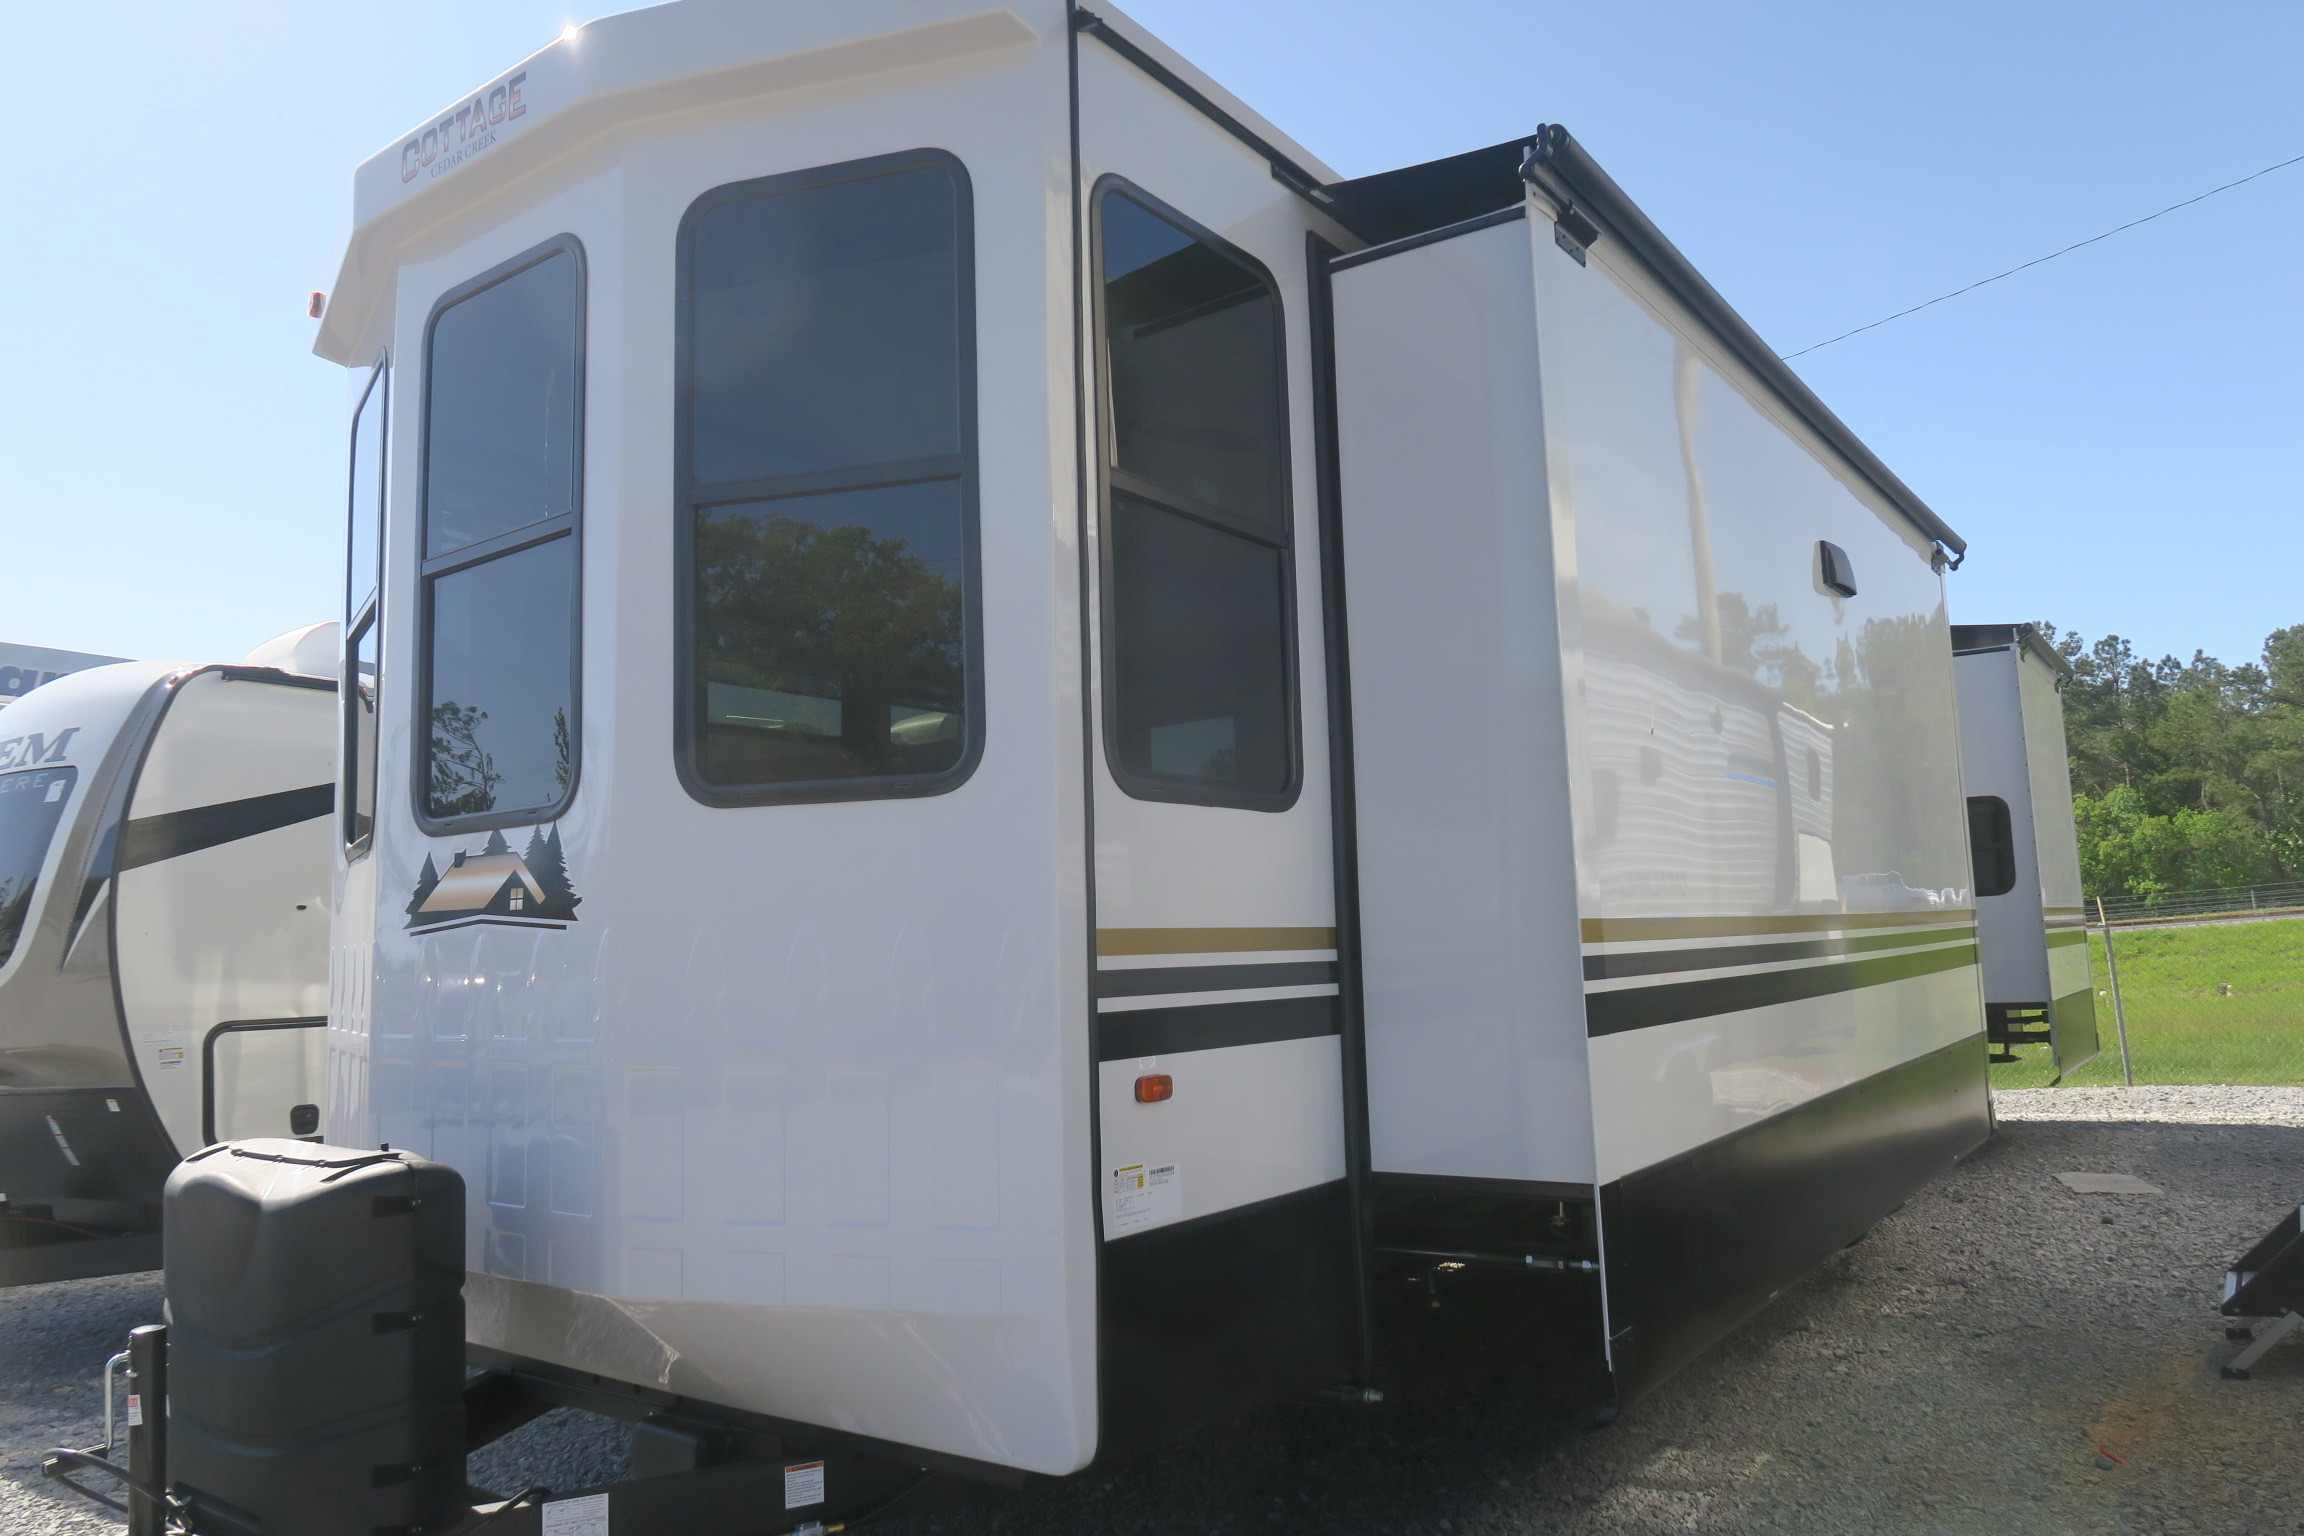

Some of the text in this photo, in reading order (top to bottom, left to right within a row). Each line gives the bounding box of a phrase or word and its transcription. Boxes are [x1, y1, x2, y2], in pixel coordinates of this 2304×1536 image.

[402, 71, 527, 184] COTTAGE
[430, 130, 497, 178] CEDAR CREEK
